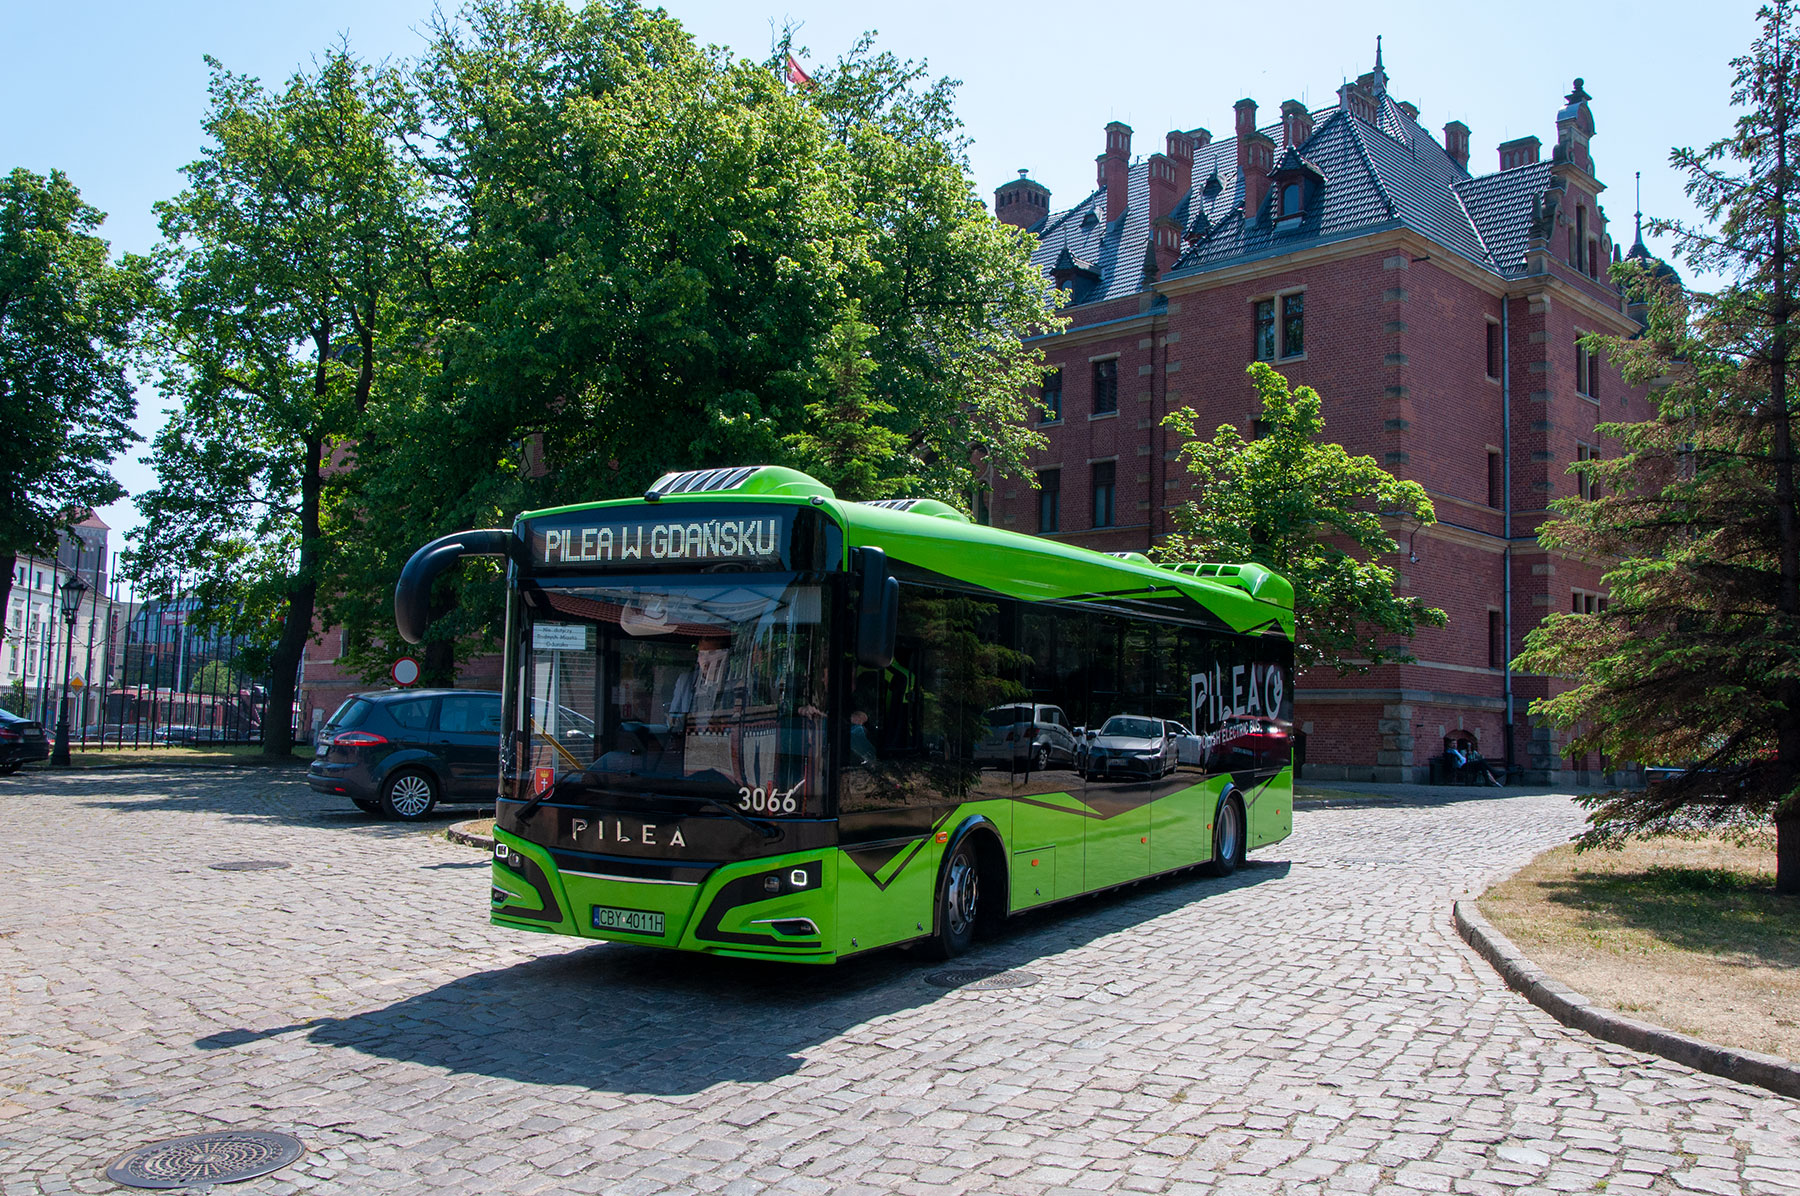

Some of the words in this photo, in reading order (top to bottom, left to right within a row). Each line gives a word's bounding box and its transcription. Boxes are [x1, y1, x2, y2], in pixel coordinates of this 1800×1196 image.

[545, 527, 614, 563] PILEA
[621, 525, 643, 560] W
[650, 519, 775, 558] GDAŃSKU
[1191, 660, 1260, 736] PILEA
[738, 786, 796, 813] 3066
[572, 818, 686, 847] PILEA
[600, 909, 622, 926] CBY
[626, 913, 663, 931] 4011H
